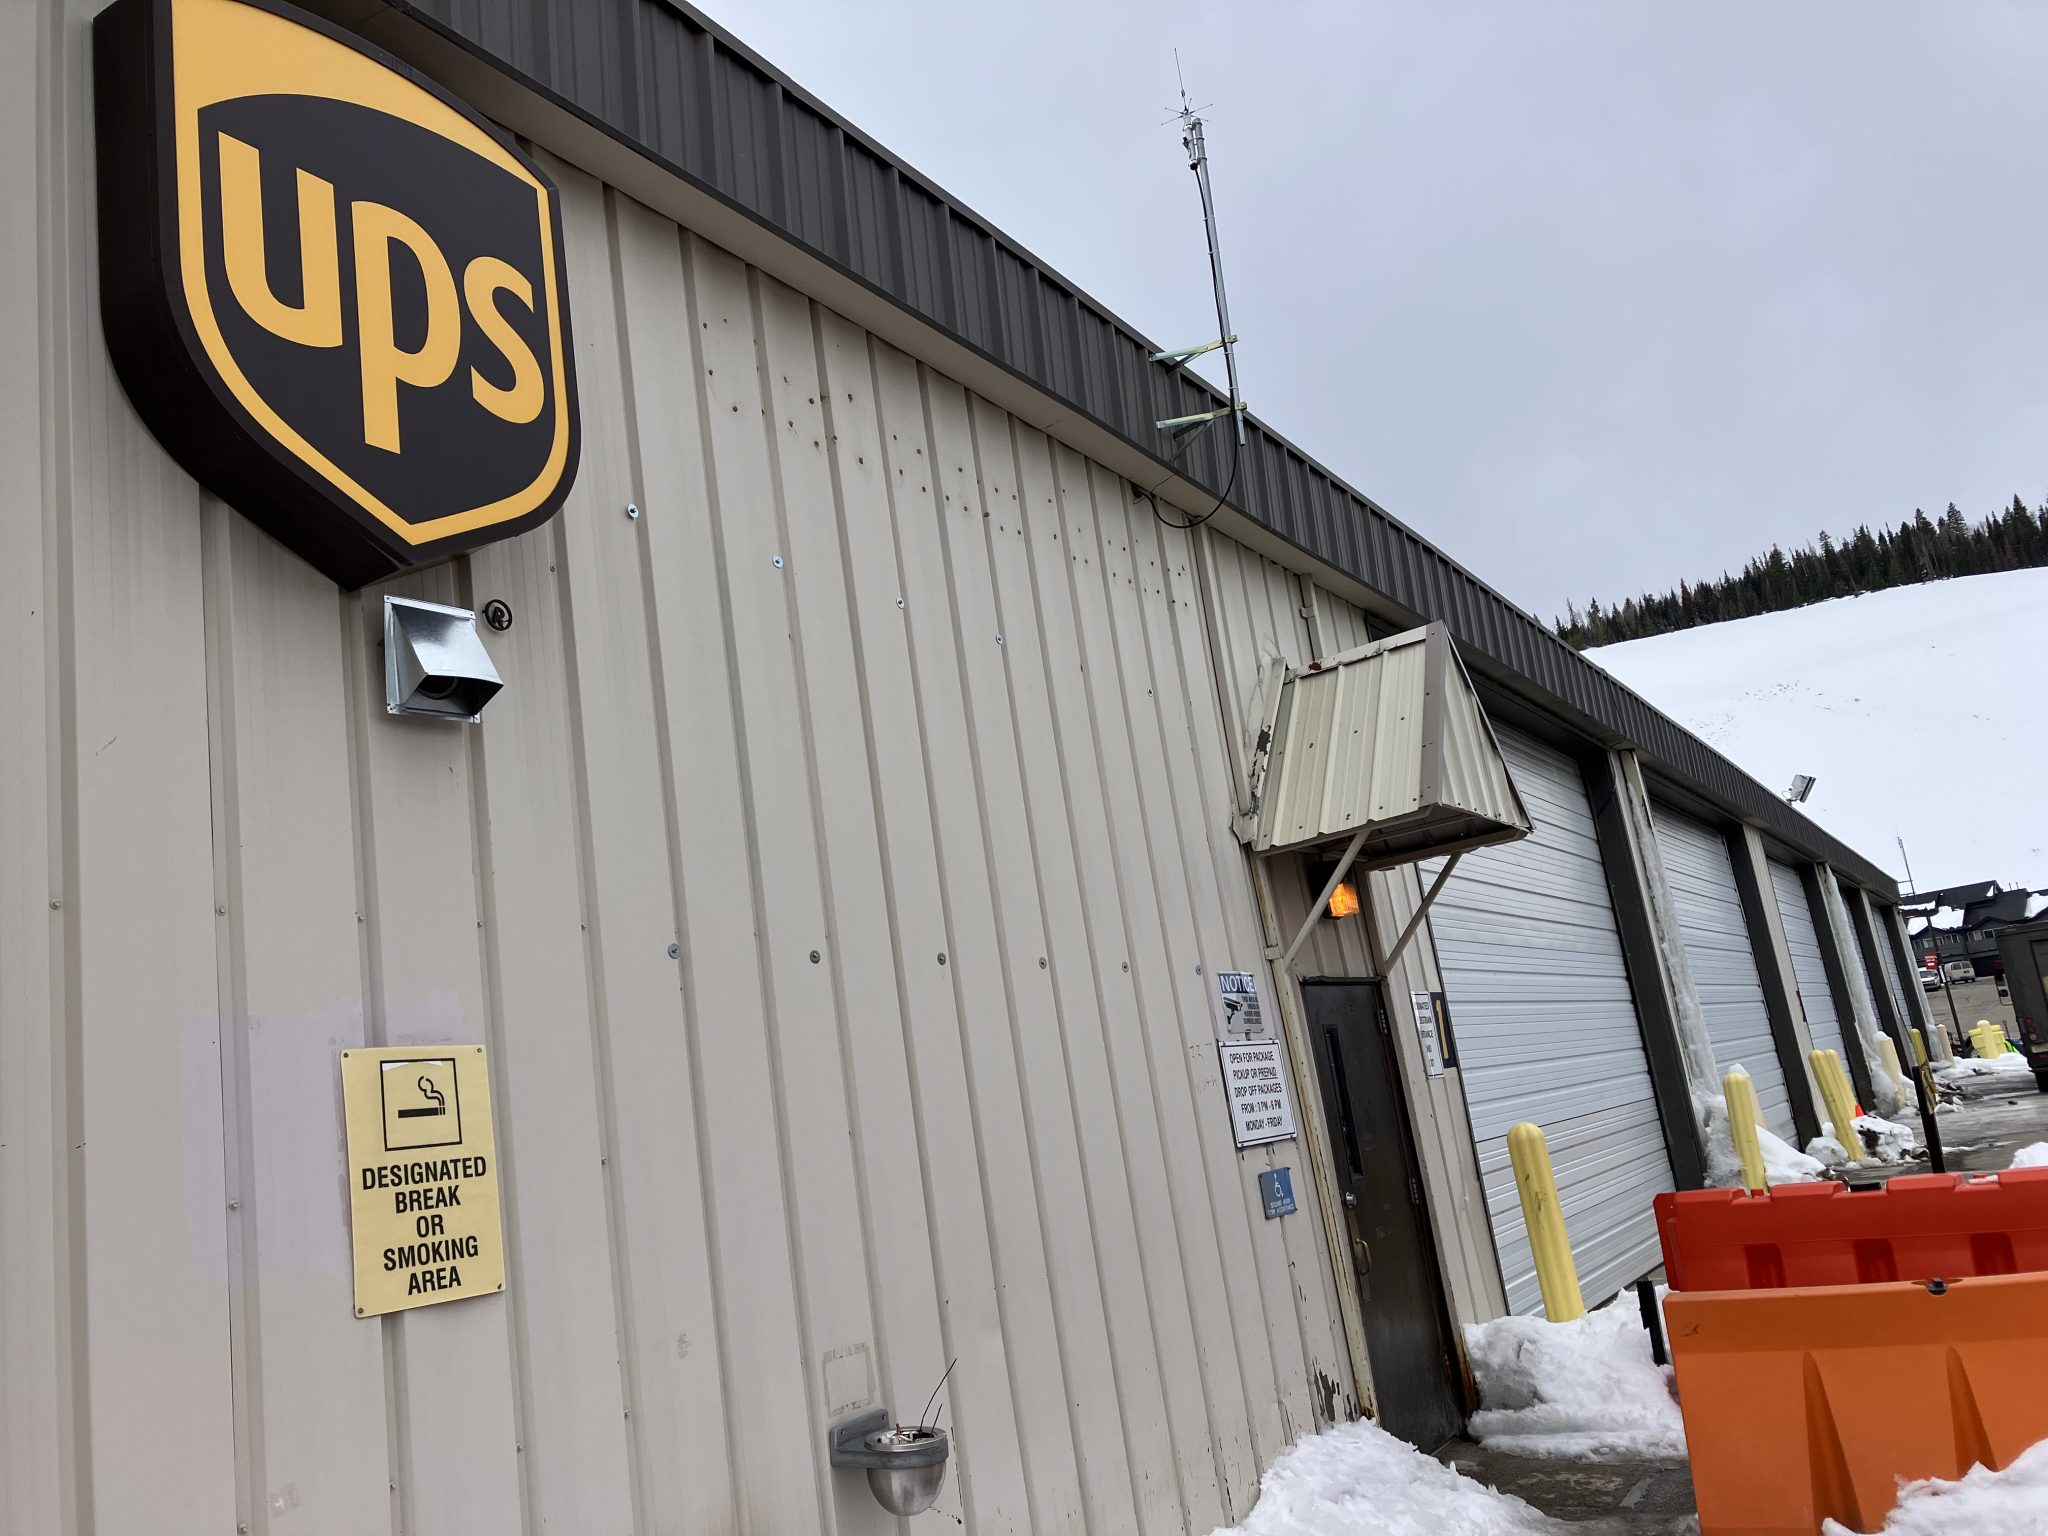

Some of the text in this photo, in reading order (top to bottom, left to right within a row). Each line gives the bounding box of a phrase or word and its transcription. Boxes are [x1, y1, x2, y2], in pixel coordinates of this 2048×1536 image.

[1220, 975, 1255, 992] NOTICE
[1229, 1050, 1275, 1064] OPEN FOR PACKAGE
[1232, 1066, 1277, 1080] PICKUP OR PREPAID
[1234, 1083, 1283, 1098] DROP OFF PACKAGES
[1261, 1101, 1269, 1112] PM
[1274, 1099, 1282, 1110] PM
[1245, 1118, 1265, 1132] MONDAY
[1266, 1116, 1283, 1129] FRIDAY
[361, 1156, 487, 1190] DESIGNATED
[395, 1184, 461, 1214] BREAK
[416, 1214, 445, 1238] OR
[383, 1235, 479, 1271] SMOKING
[407, 1265, 462, 1296] AREA
